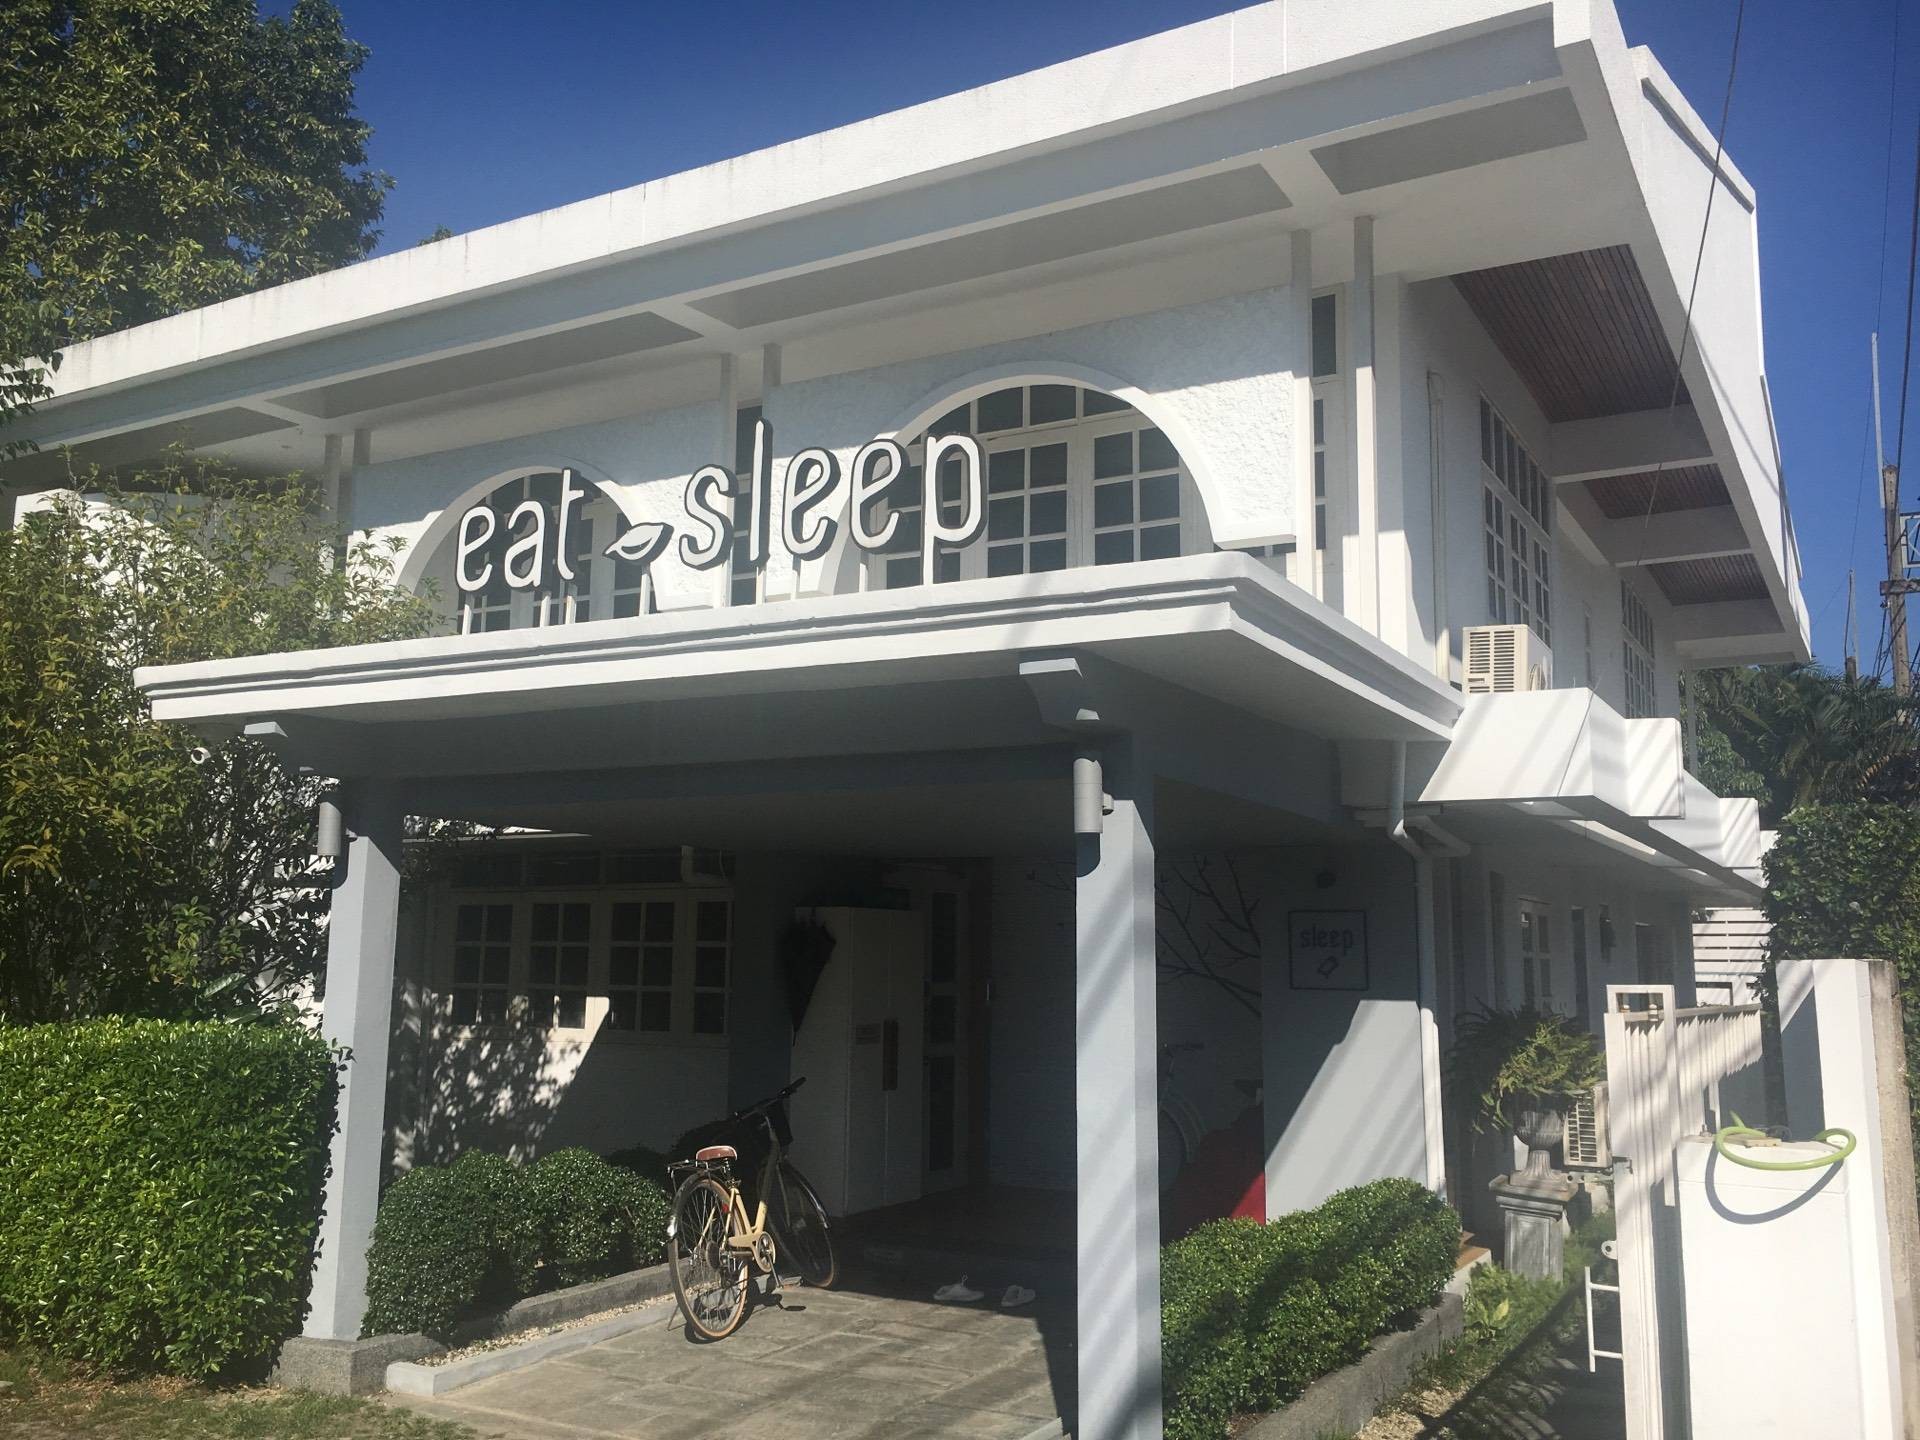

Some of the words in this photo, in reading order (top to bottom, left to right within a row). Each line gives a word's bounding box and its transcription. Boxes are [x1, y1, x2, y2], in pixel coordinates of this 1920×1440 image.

[455, 467, 585, 592] eat
[678, 417, 988, 586] sleep
[1300, 923, 1353, 957] sleep
